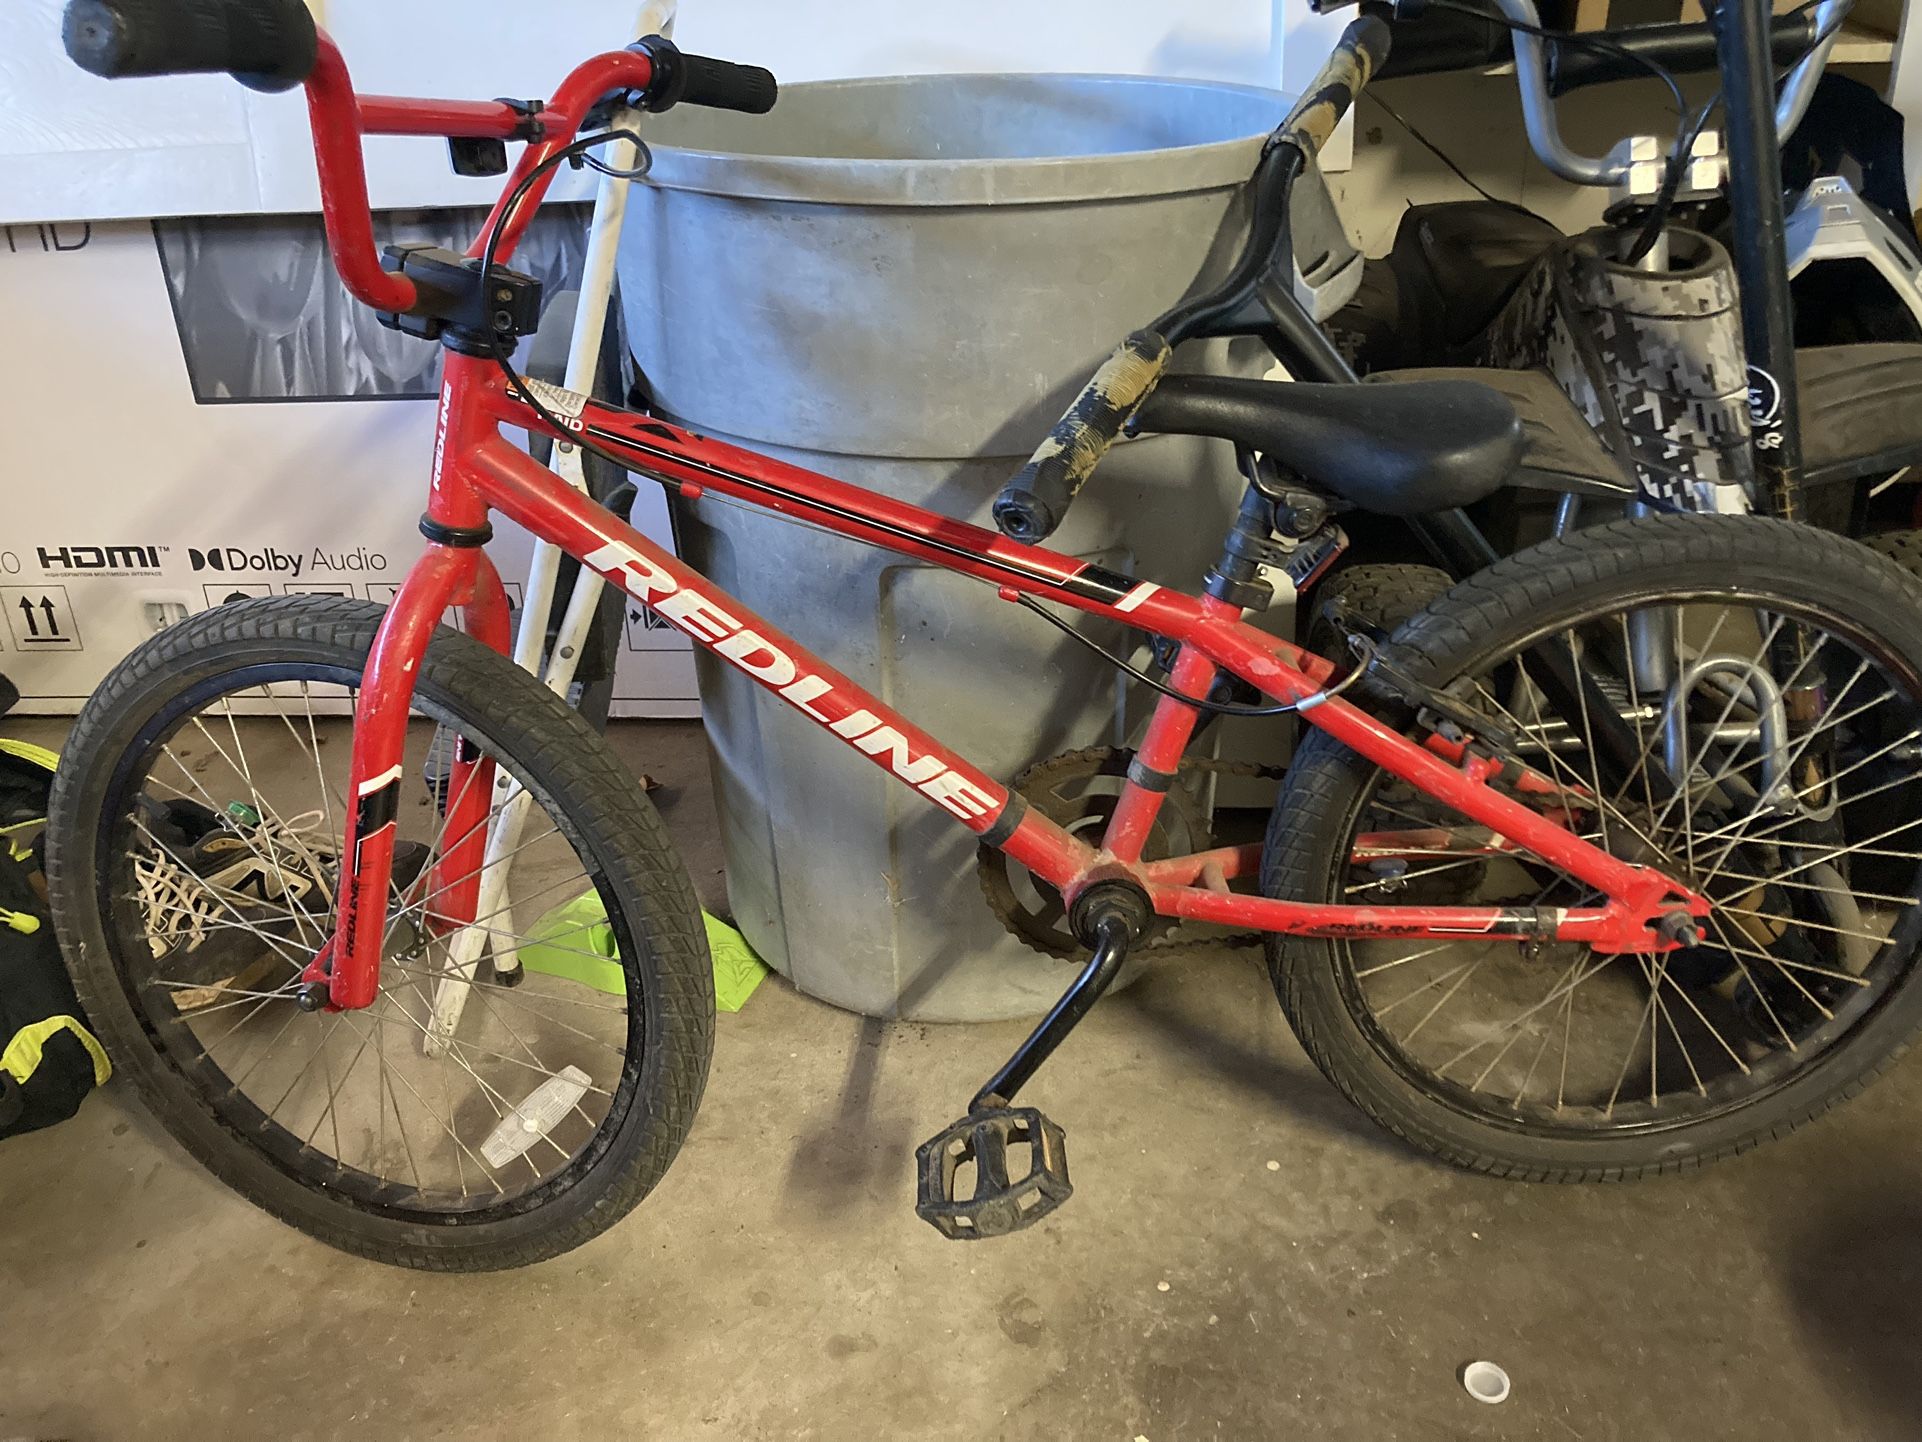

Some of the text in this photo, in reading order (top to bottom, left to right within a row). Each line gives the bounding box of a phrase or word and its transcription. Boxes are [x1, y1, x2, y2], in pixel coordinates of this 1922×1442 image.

[432, 379, 452, 492] REDLINE
[226, 547, 387, 577] Dolby Audio
[583, 540, 1000, 820] REDLINE
